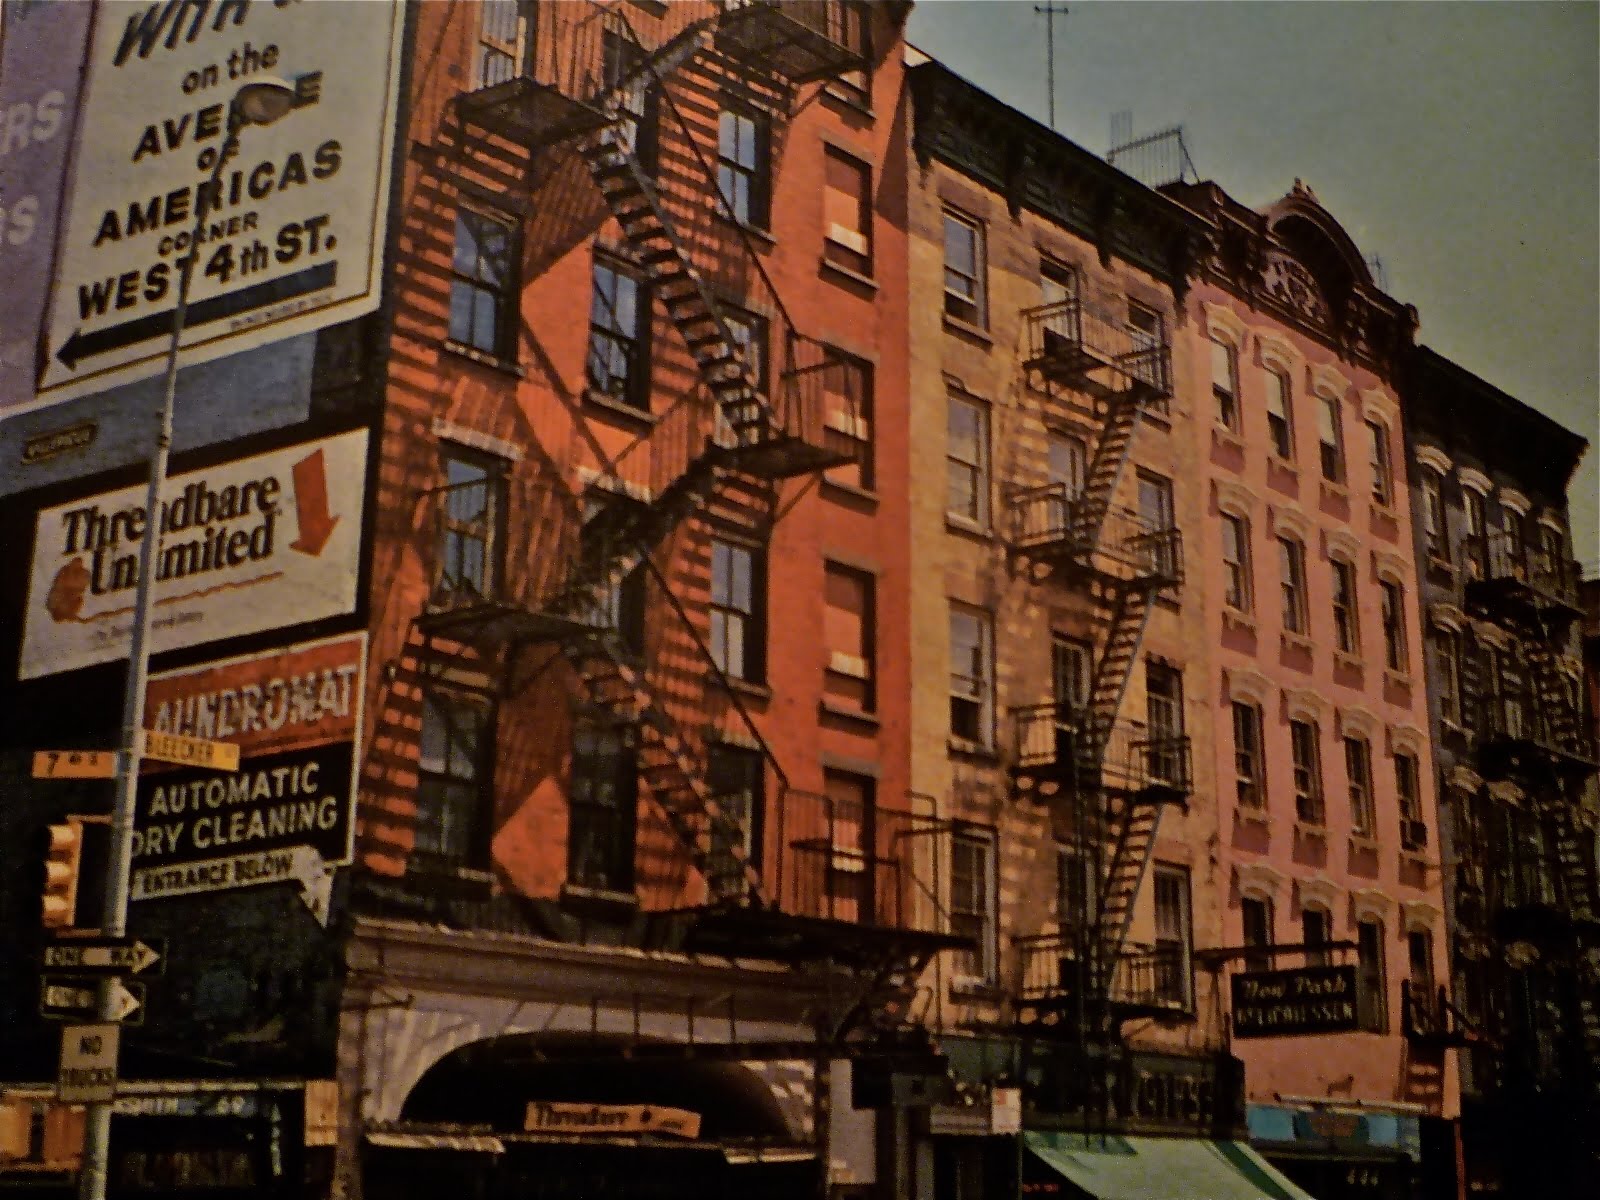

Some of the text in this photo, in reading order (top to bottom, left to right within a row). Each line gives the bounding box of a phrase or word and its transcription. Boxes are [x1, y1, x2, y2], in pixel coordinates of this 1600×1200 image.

[181, 42, 281, 95] on the
[132, 71, 323, 163] AVEE
[93, 139, 342, 247] AMERICAS
[78, 256, 197, 320] WEST
[204, 240, 269, 285] 4th
[275, 214, 338, 264] ST.
[90, 511, 278, 595] Unimited
[152, 664, 357, 739] AUNDROMAT
[150, 762, 320, 818] AUTOMATIC
[132, 796, 339, 858] DRY CLEANING
[143, 853, 293, 893] ENTRANCE BELOW
[80, 1035, 102, 1055] NO
